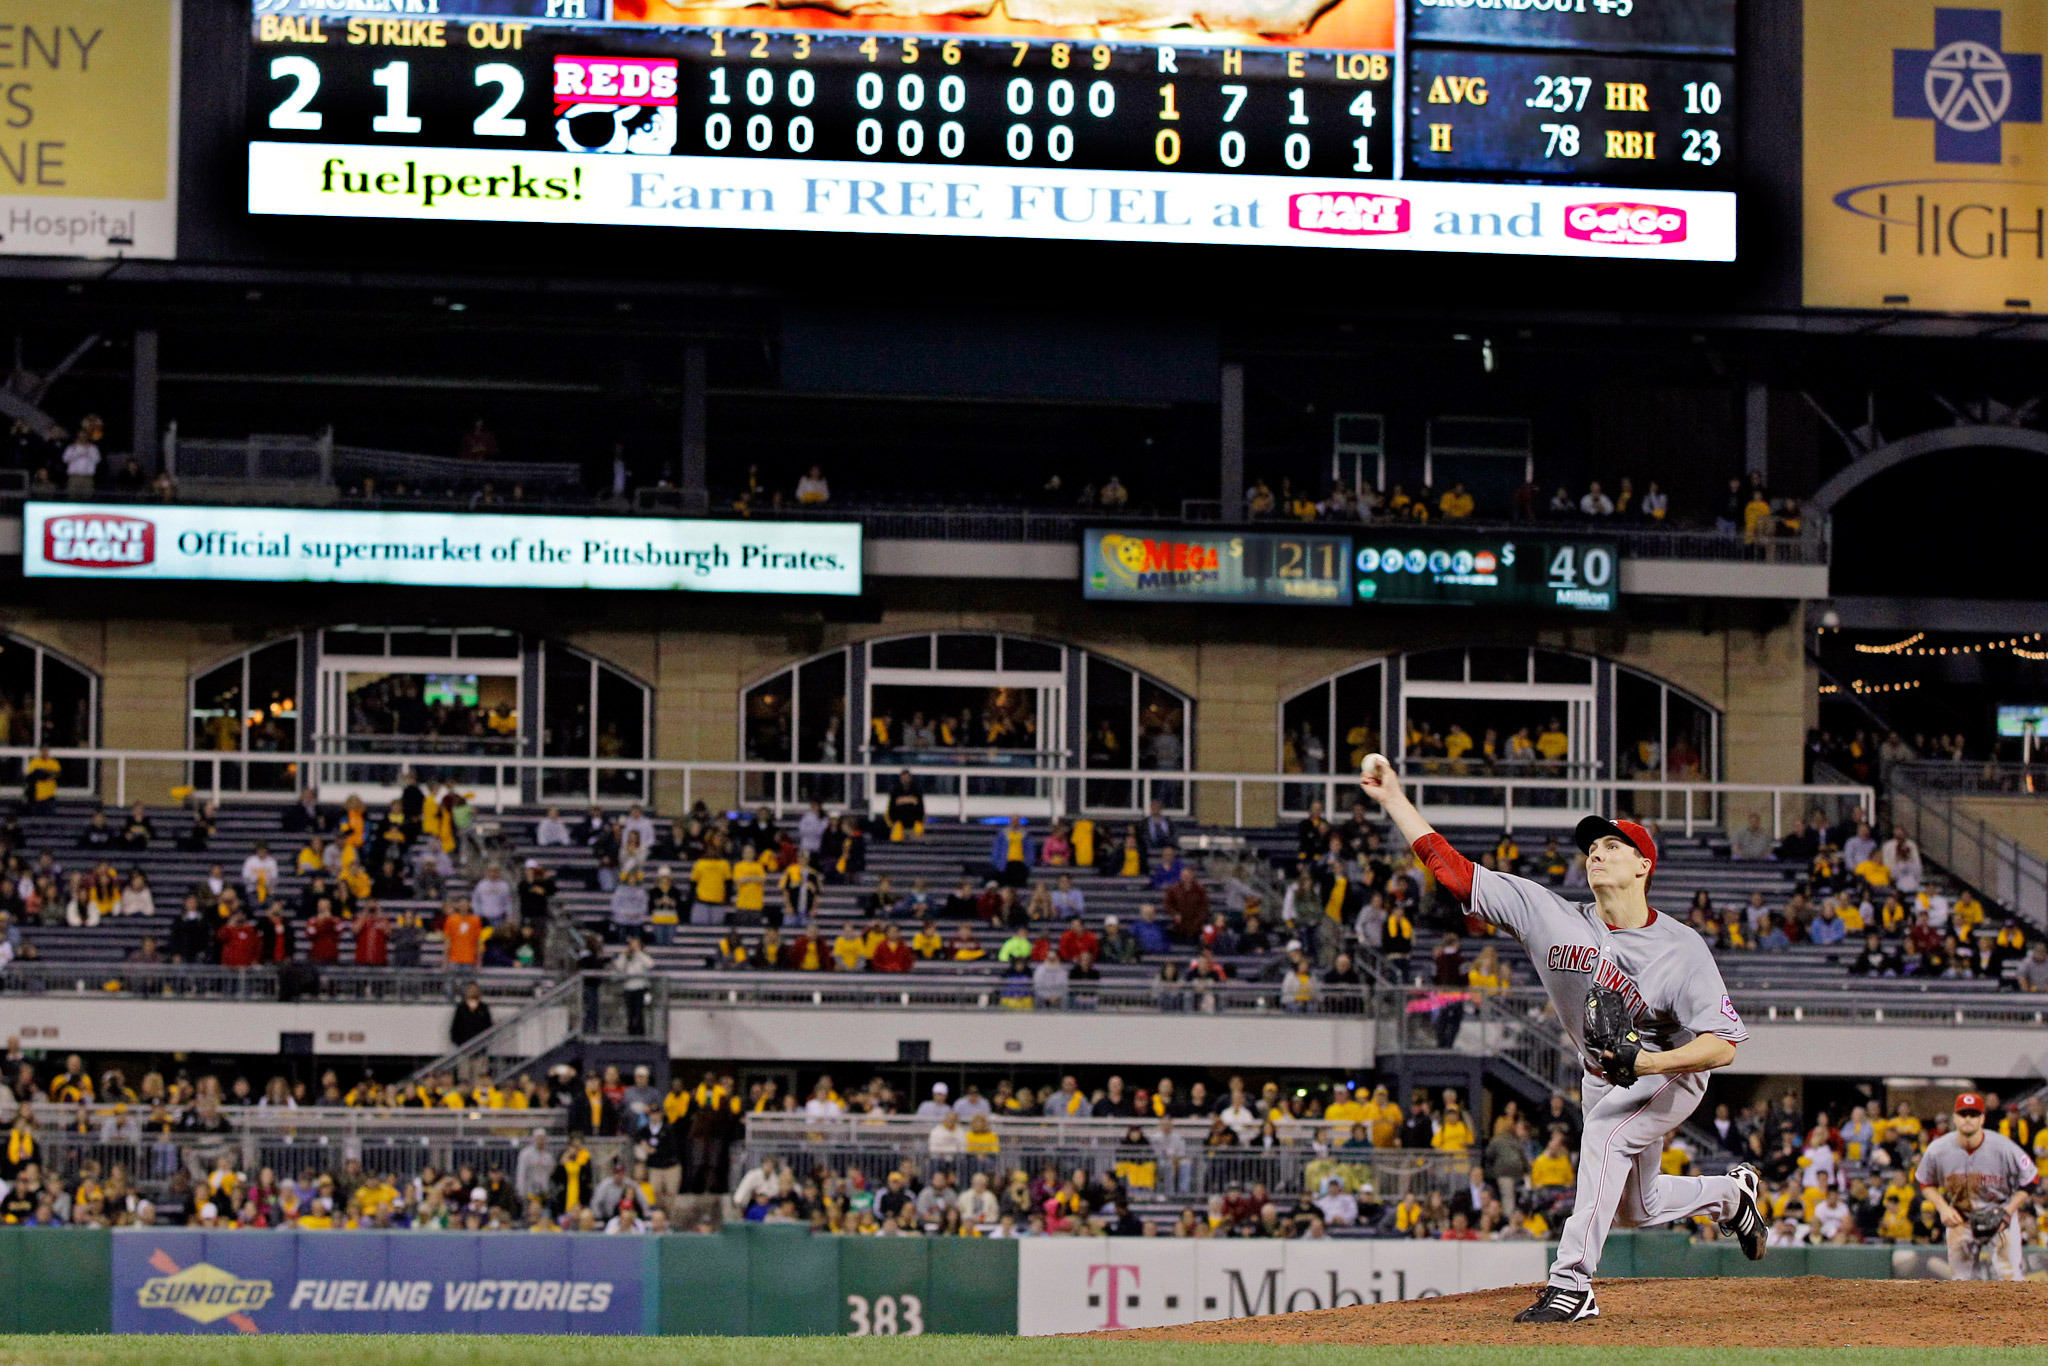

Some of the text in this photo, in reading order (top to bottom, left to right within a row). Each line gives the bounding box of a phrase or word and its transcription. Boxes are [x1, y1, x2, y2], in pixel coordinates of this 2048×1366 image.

[259, 14, 527, 50] BALL STRIKE OUT
[710, 32, 1389, 81] 1 2 3 4 5 6 7 8 9 R H E LOB
[268, 55, 526, 136] 2 1 2
[554, 62, 678, 98] REDS
[709, 67, 1376, 128] 1 0 0 0 0 0 0 0 0 1 7 1 4
[1428, 75, 1721, 114] AVG .237 HR 10
[705, 113, 1373, 172] 0 0 0 0 0 0 0 0 0 0 0 1
[1429, 123, 1721, 166] H 78 RBI 23
[320, 158, 1267, 229] fuelperks! Earn FREE FUEL at
[9, 209, 136, 244] Hospital
[1433, 203, 1543, 238] and
[1879, 193, 2043, 260] HIGH
[50, 519, 148, 543] GIANT
[52, 540, 145, 563] EAGLE
[178, 529, 846, 576] Official supermarket of the Pittsburgh Pirates.
[1140, 538, 1219, 572] MEGA
[1279, 542, 1334, 578] 21
[1550, 546, 1612, 587] 40
[146, 1281, 265, 1306] SUNOCO
[289, 1279, 614, 1313] FUELING VICTORIES
[1223, 1268, 1444, 1319] Mobil
[847, 1294, 925, 1336] 383
